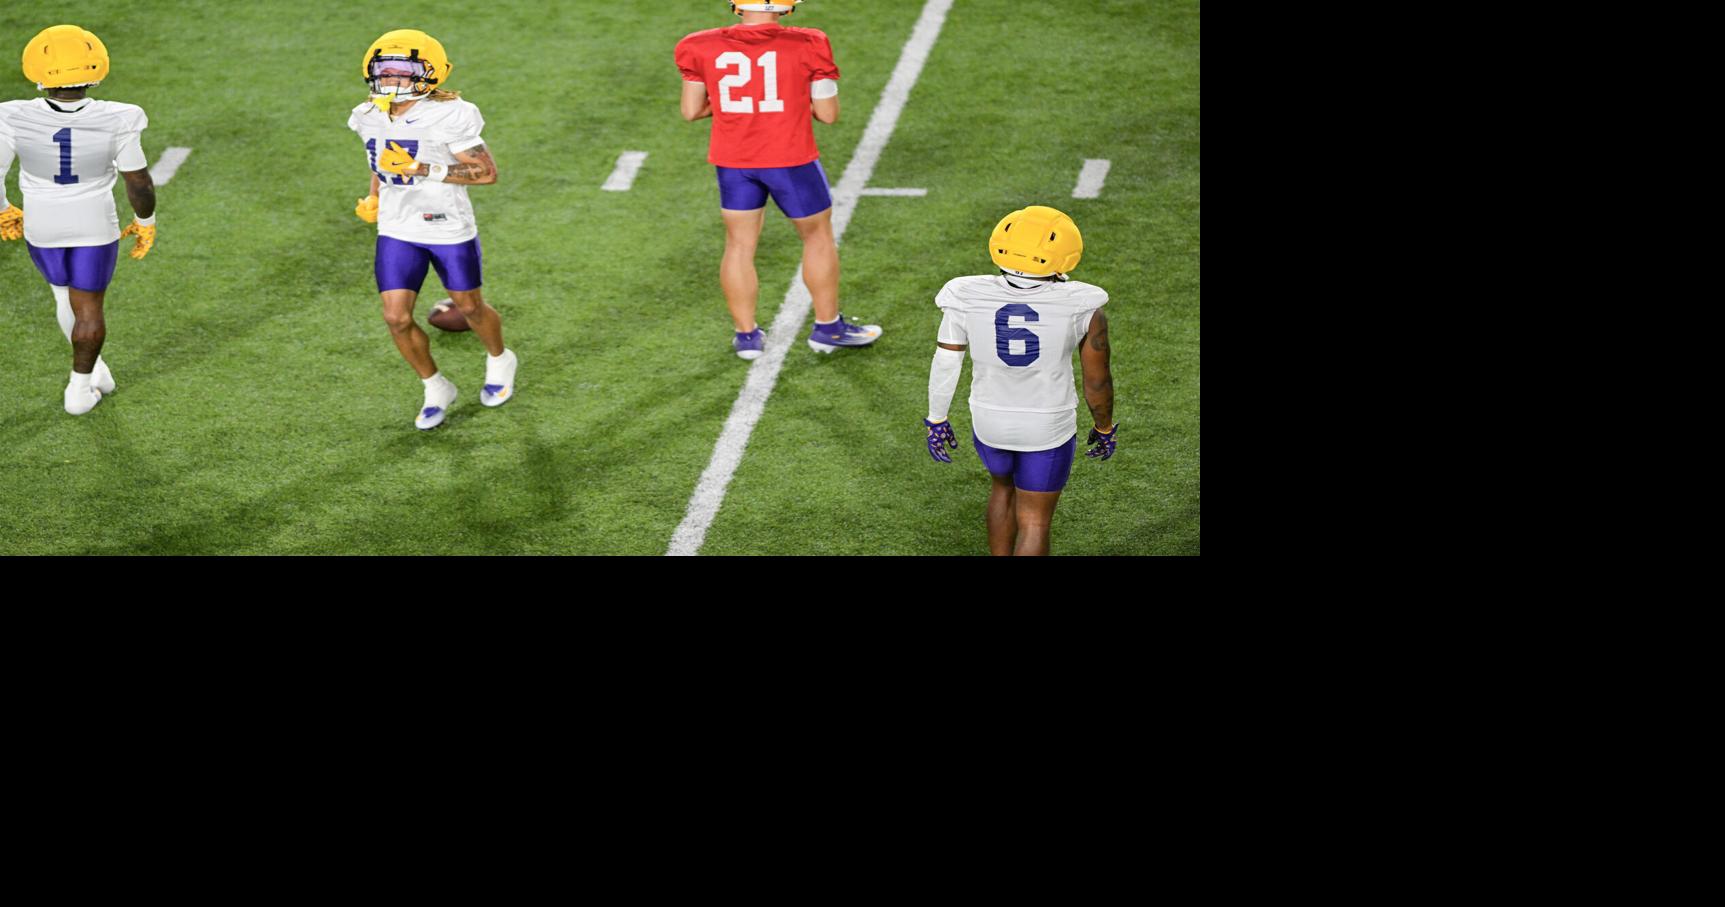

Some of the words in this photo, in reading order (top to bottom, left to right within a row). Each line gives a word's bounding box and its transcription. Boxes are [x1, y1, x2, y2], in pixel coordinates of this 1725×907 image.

[715, 51, 784, 113] 21
[53, 128, 79, 185] 1
[995, 304, 1040, 366] 6
